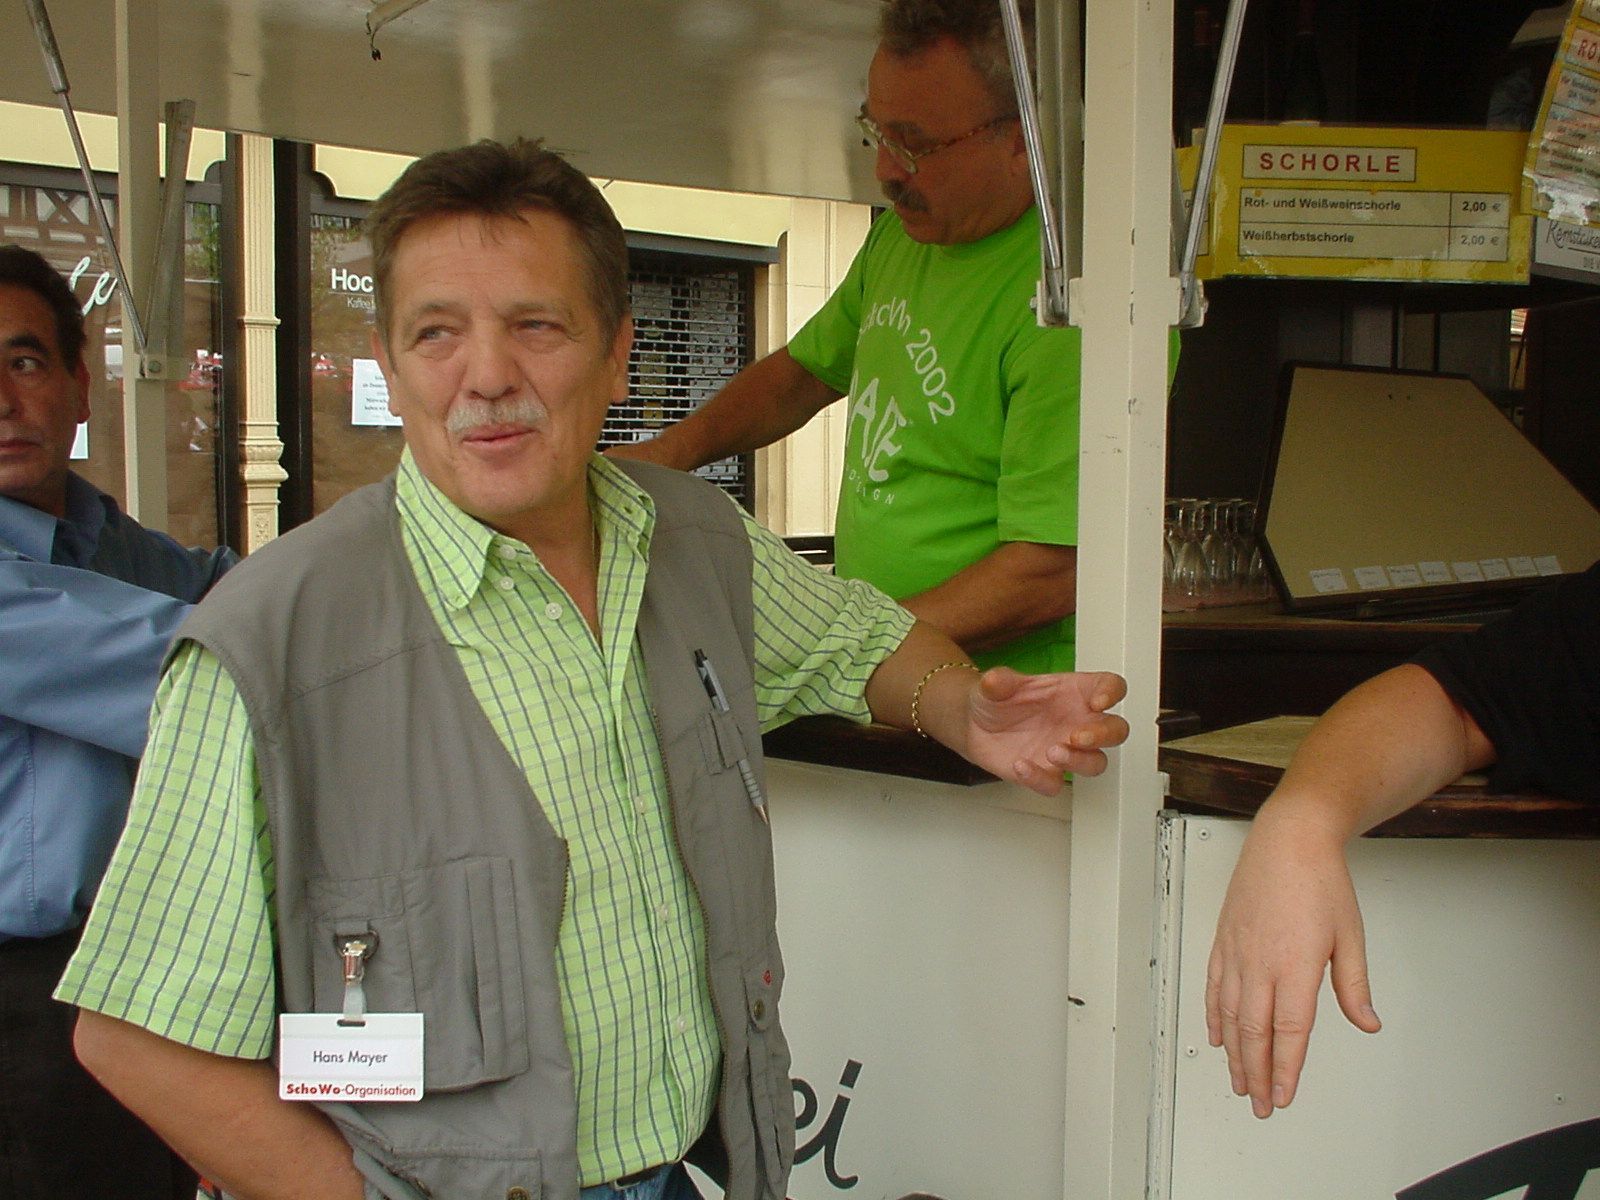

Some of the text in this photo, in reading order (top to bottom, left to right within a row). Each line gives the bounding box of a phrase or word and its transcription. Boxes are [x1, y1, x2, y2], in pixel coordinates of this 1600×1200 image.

[1259, 152, 1401, 174] SCHORLE
[1244, 196, 1269, 208] Rot-
[1273, 197, 1296, 208] und
[1299, 197, 1401, 211] Weißweinschorle
[1461, 201, 1487, 213] 2,00
[1460, 234, 1485, 247] 2,00
[905, 328, 956, 425] 2002
[313, 1050, 388, 1066] Hans Mayer
